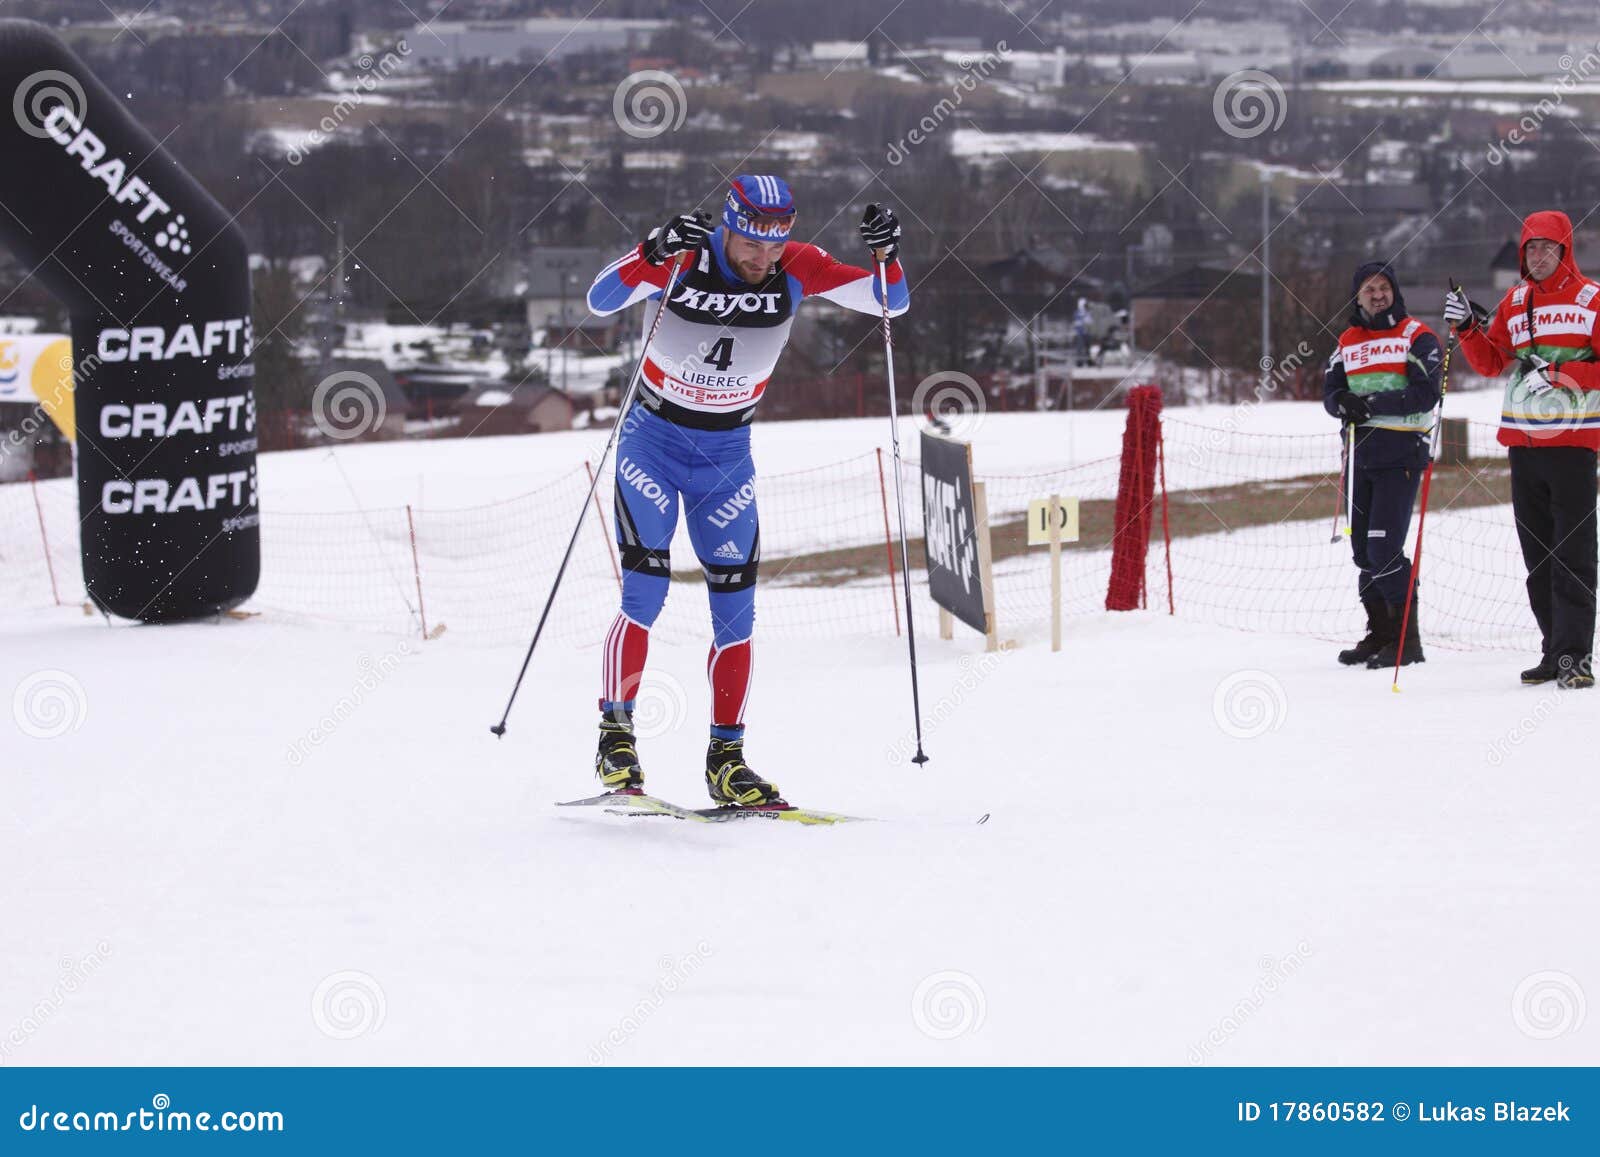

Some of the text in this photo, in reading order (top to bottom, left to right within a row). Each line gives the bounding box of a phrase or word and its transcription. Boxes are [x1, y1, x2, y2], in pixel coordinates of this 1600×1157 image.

[44, 105, 171, 224] CRAFT
[109, 220, 187, 293] SPORTSWEAR
[671, 286, 784, 318] KAJOT
[98, 319, 243, 362] CRAFT
[703, 337, 735, 371] 4
[682, 370, 748, 387] LIBEREC
[100, 395, 245, 438] CRAFT
[102, 471, 248, 514] CRAFT
[619, 457, 671, 514] LUKOIL
[713, 550, 744, 560] adidas
